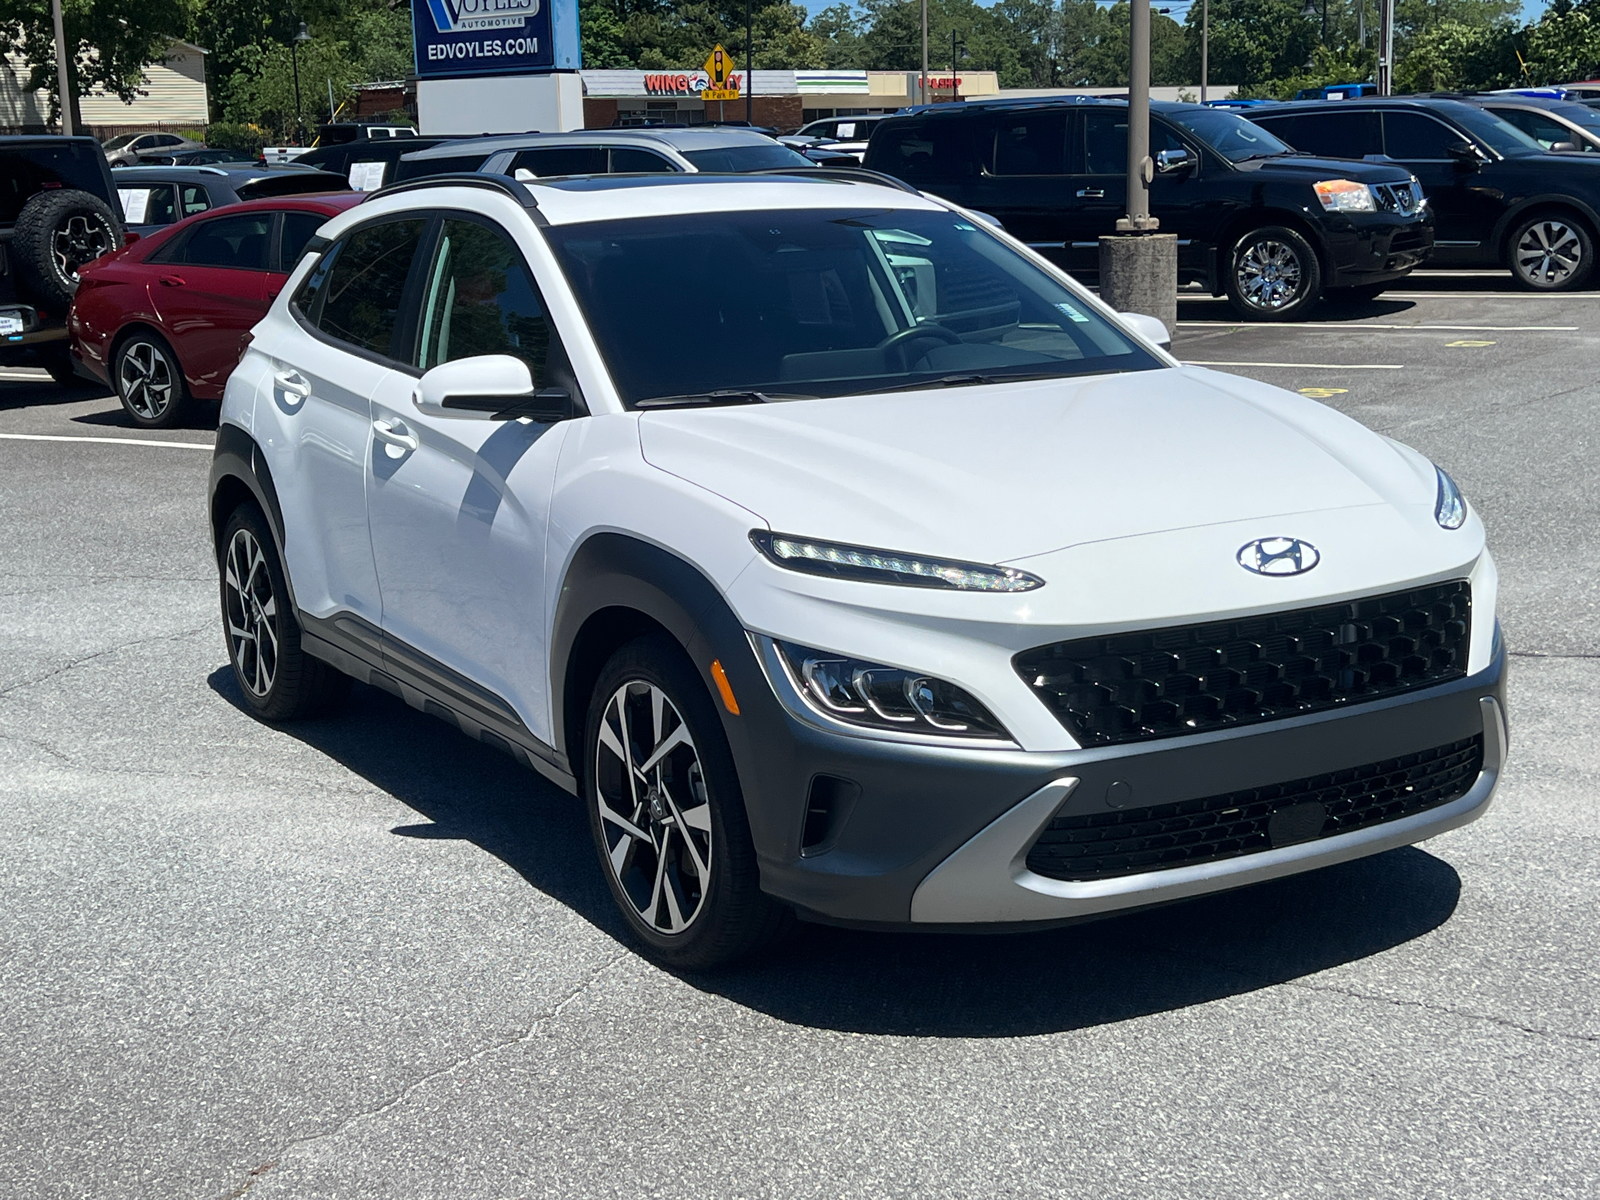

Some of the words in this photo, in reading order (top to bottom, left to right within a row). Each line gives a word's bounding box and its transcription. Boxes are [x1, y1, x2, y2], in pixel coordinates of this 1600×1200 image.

[461, 17, 523, 29] AUTOMOTIVE
[428, 37, 538, 60] EDVOYLES.COM
[645, 74, 688, 91] WING
[709, 74, 742, 90] CTY
[712, 91, 726, 99] Park
